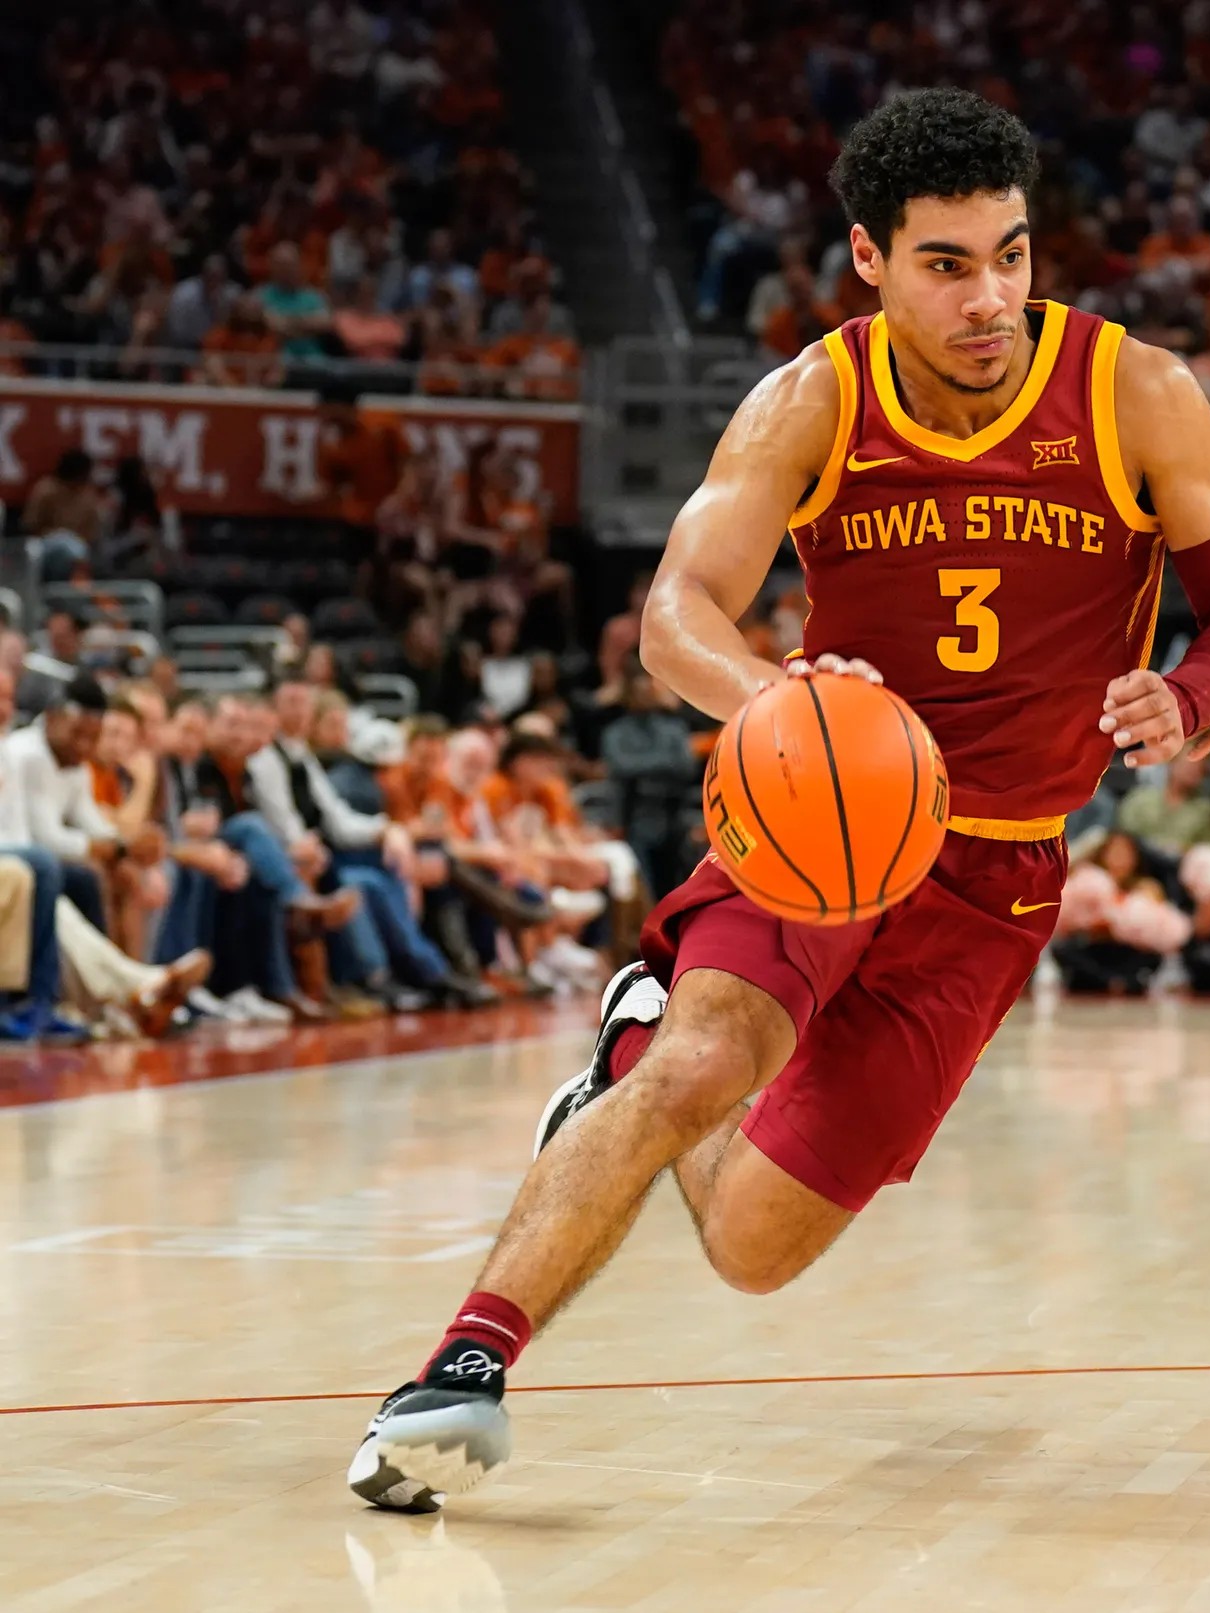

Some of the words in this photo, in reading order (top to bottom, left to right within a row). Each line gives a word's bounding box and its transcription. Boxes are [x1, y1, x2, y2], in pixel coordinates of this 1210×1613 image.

[840, 498, 946, 551] IOWA
[965, 496, 1105, 554] STATE
[936, 568, 1001, 672] 3
